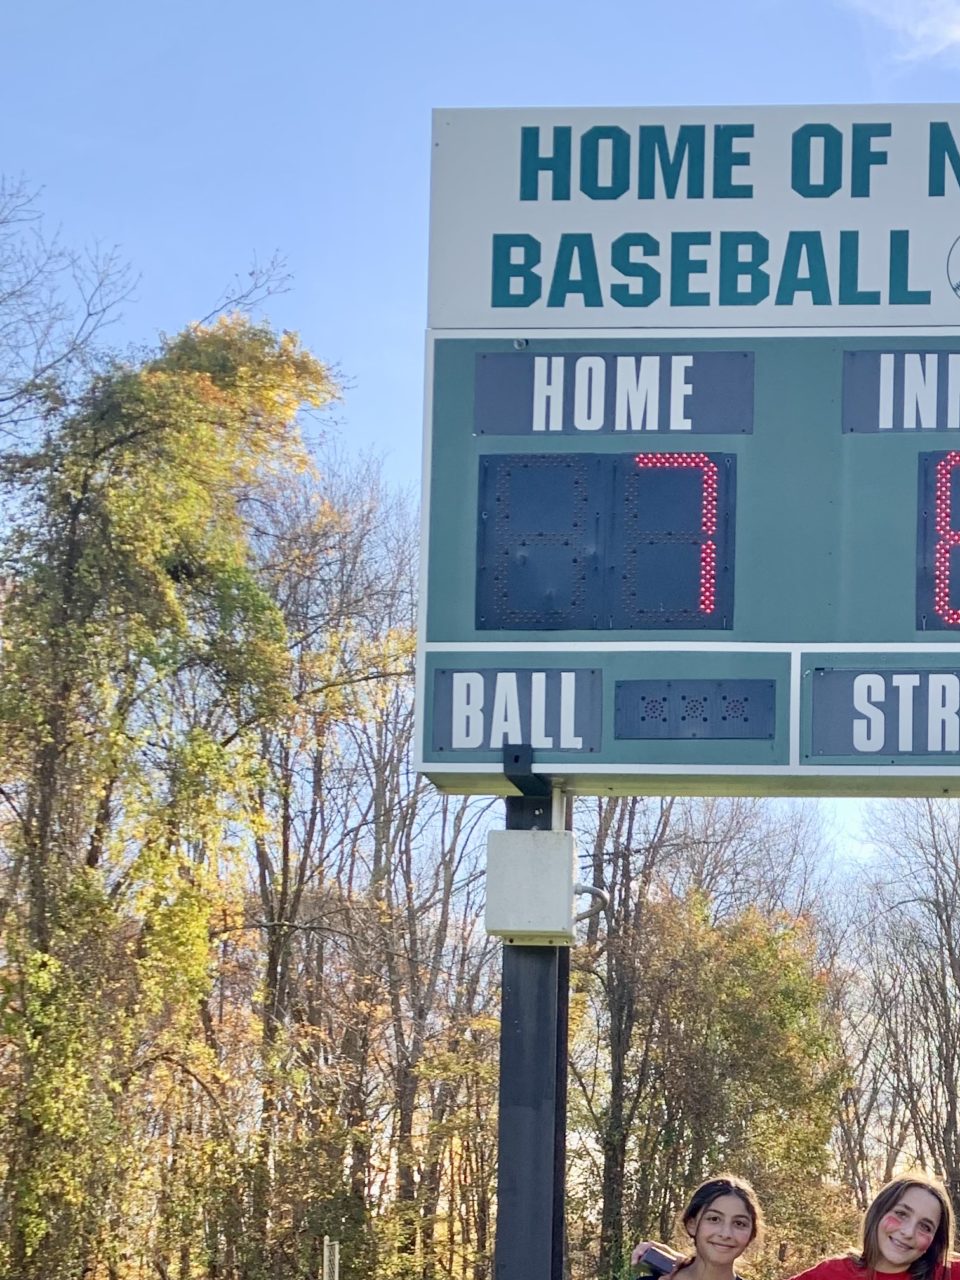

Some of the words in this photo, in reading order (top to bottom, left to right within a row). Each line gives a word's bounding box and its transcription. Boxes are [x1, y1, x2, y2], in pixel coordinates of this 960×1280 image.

[520, 124, 754, 201] HOME
[791, 123, 892, 199] OF
[491, 229, 932, 308] BASEBALL
[532, 355, 695, 432] HOME
[634, 452, 719, 614] 7
[451, 670, 583, 750] BALL
